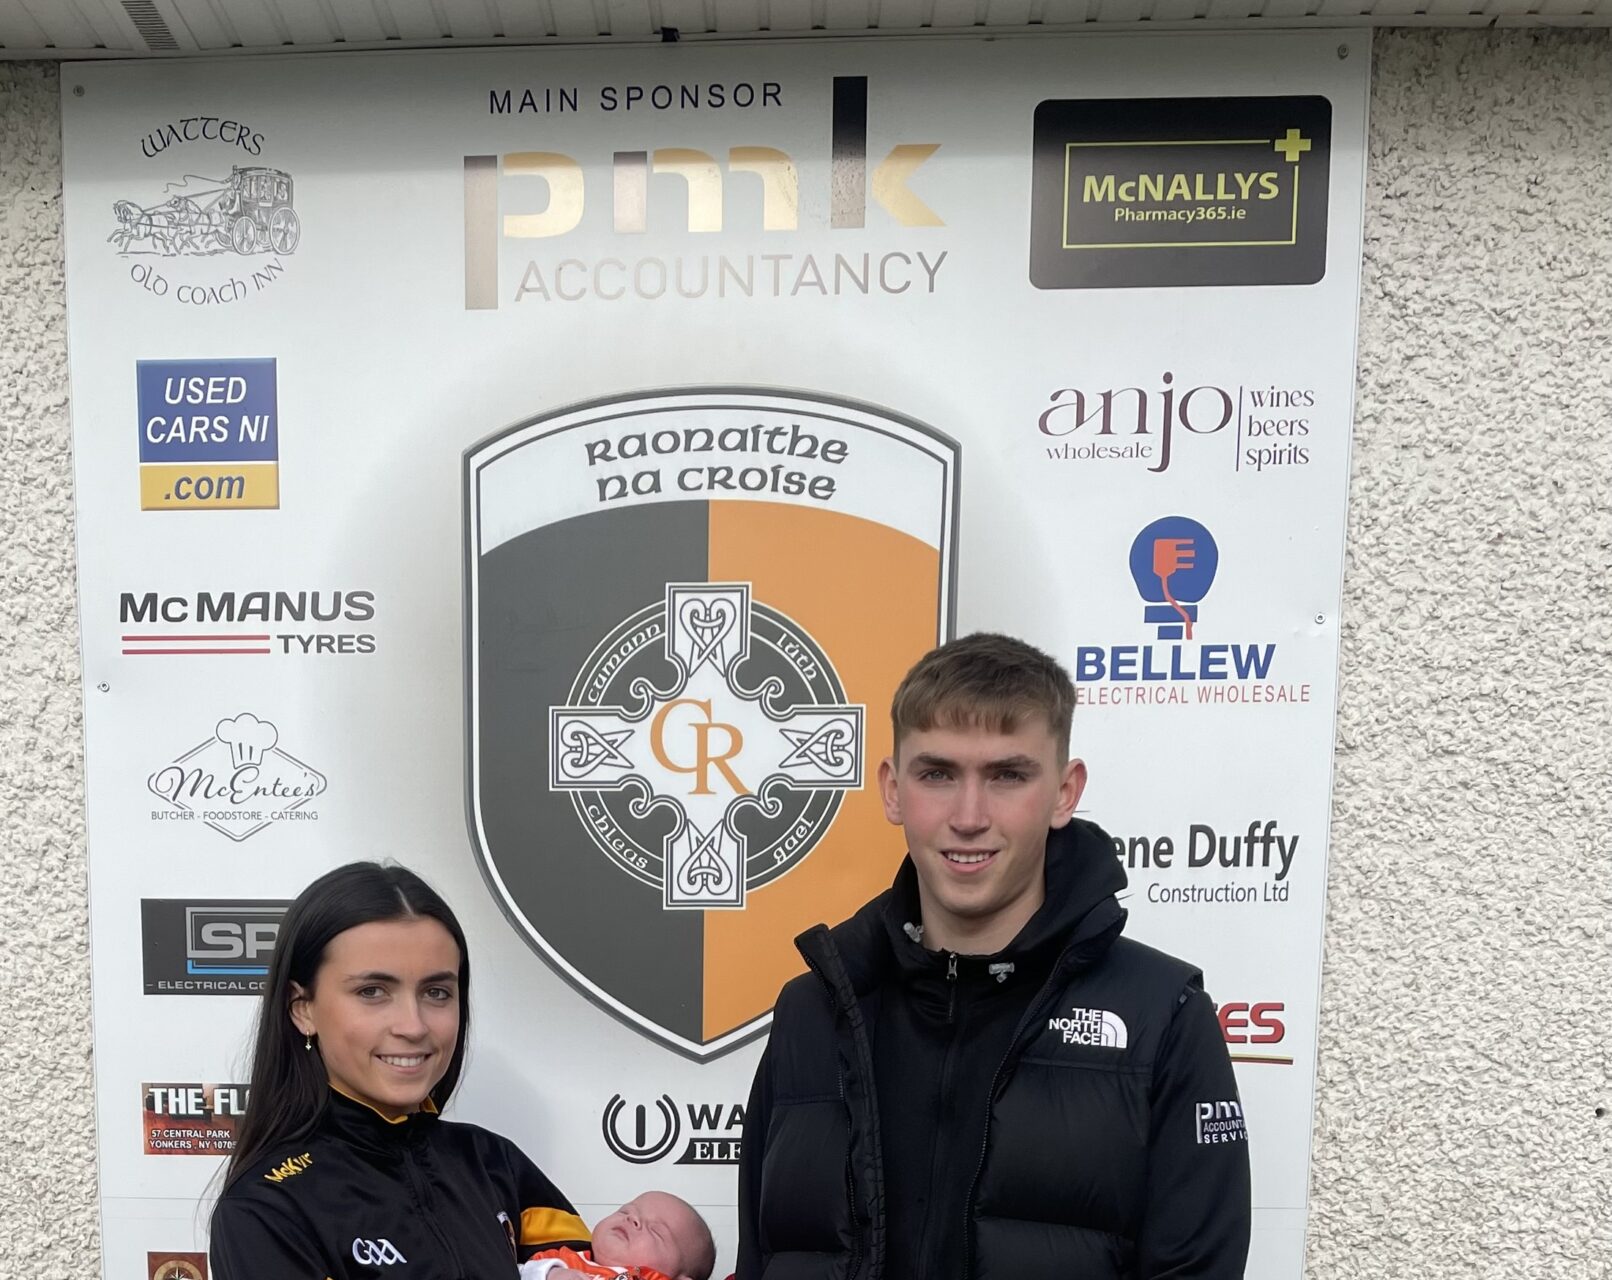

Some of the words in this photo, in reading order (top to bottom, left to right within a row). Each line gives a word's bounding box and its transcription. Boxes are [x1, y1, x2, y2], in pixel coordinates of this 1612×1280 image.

[489, 87, 580, 115] MAIN
[600, 82, 783, 111] SPONSOR
[141, 116, 265, 158] WATTERS
[463, 76, 948, 311] pmk
[1082, 171, 1280, 203] McNALLYS
[1114, 206, 1247, 224] Pharmacy365.ie
[251, 257, 286, 292] INN
[514, 250, 949, 303] ACCOUNTANCY
[164, 376, 247, 405] USED
[1250, 385, 1315, 408] wines
[145, 415, 231, 444] CARS
[238, 415, 270, 443] NI
[1037, 371, 1234, 473] anjo
[1247, 414, 1310, 437] beers
[1046, 442, 1153, 460] wholesale
[1245, 444, 1310, 471] spirits
[164, 474, 246, 500] .com
[597, 468, 662, 501] na
[276, 634, 376, 654] TYRES
[1075, 643, 1276, 682] BELLEW
[1076, 686, 1189, 706] ELECTRICAL
[1197, 684, 1311, 704] WHOLESALE
[649, 698, 753, 795] CR
[155, 766, 317, 805] McEntee's
[151, 811, 195, 821] BUTCHER
[203, 811, 263, 821] FOODSTORE
[271, 811, 318, 821] CATERING
[1188, 820, 1300, 881] Duffy
[1148, 881, 1257, 903] Construction
[1263, 880, 1290, 902] Ltd
[158, 980, 246, 990] ELECTRICAL
[1049, 1018, 1101, 1033] NORTH
[1072, 1008, 1102, 1021] THE
[1213, 1002, 1285, 1044] ES
[1063, 1030, 1101, 1046] FACE
[149, 1088, 204, 1115] THE
[152, 1130, 161, 1138] 57
[163, 1130, 204, 1138] CENTRAL
[207, 1130, 230, 1138] PARK
[1195, 1100, 1242, 1144] pm
[150, 1140, 191, 1149] YONKERS
[199, 1141, 211, 1149] NY
